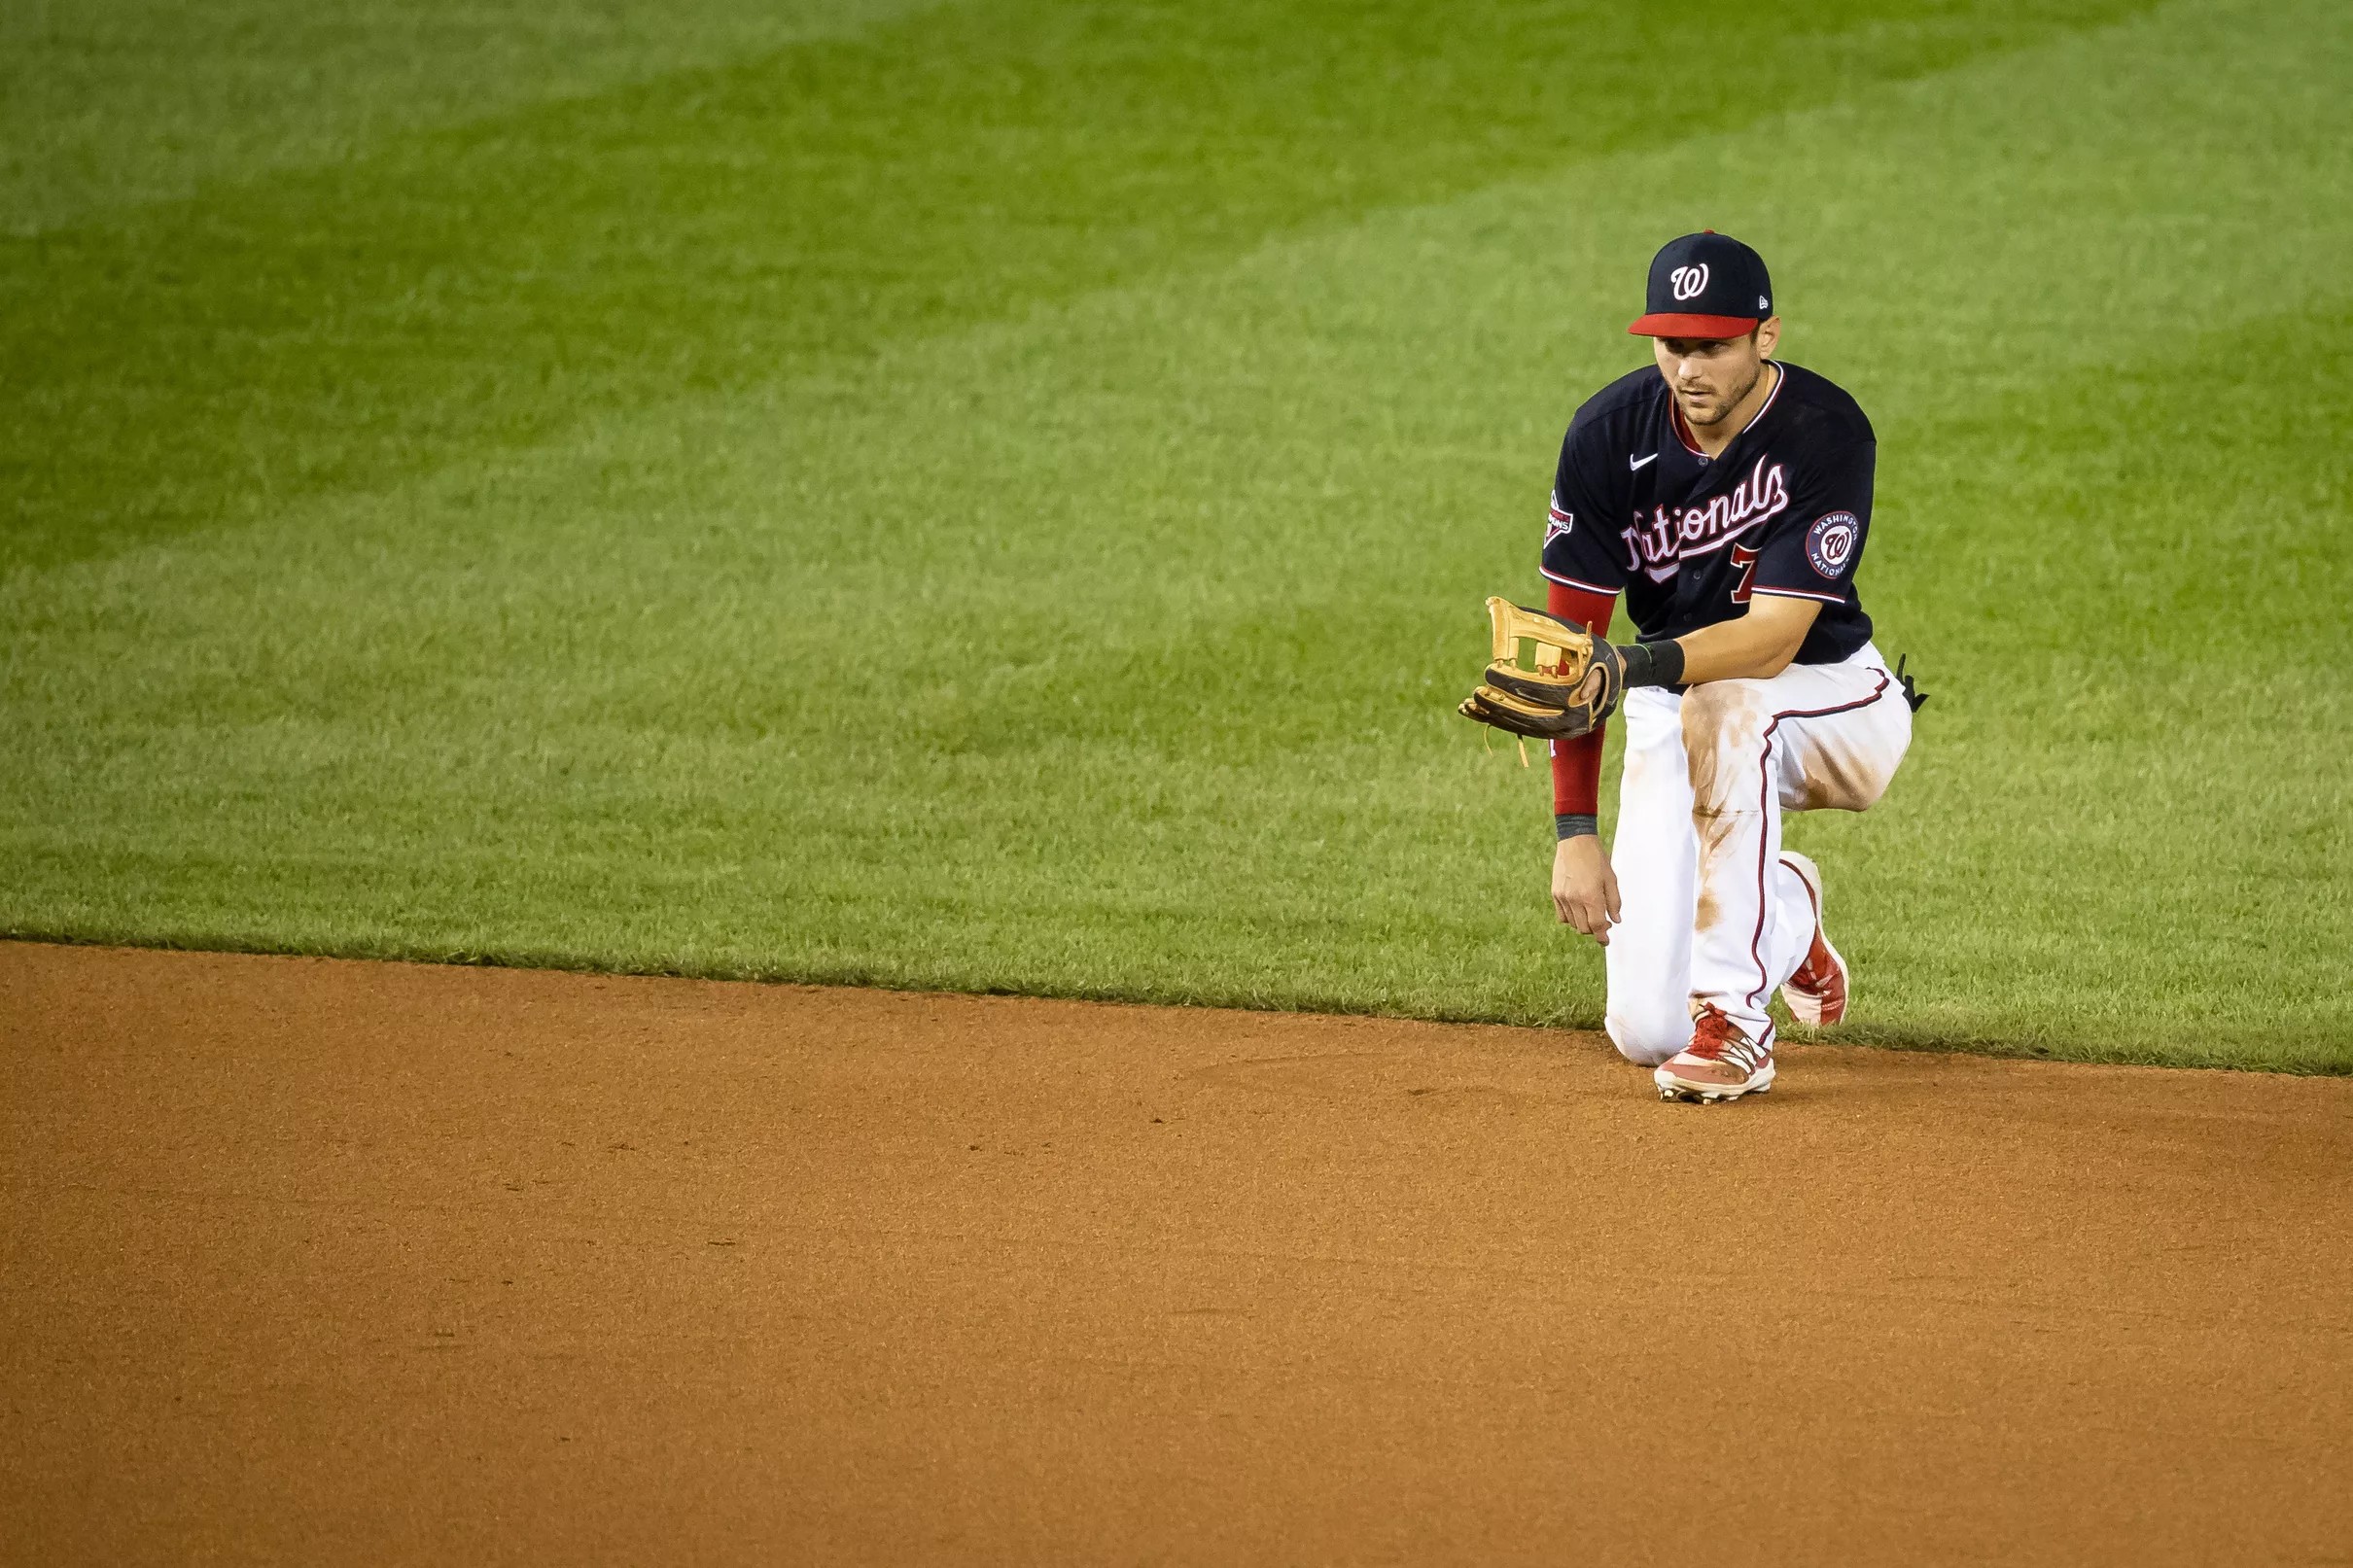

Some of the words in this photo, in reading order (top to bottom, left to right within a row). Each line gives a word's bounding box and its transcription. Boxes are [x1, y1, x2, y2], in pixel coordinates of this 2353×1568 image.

[1670, 262, 1709, 301] W
[1620, 452, 1790, 574] Nationals
[1730, 542, 1762, 604] 7
